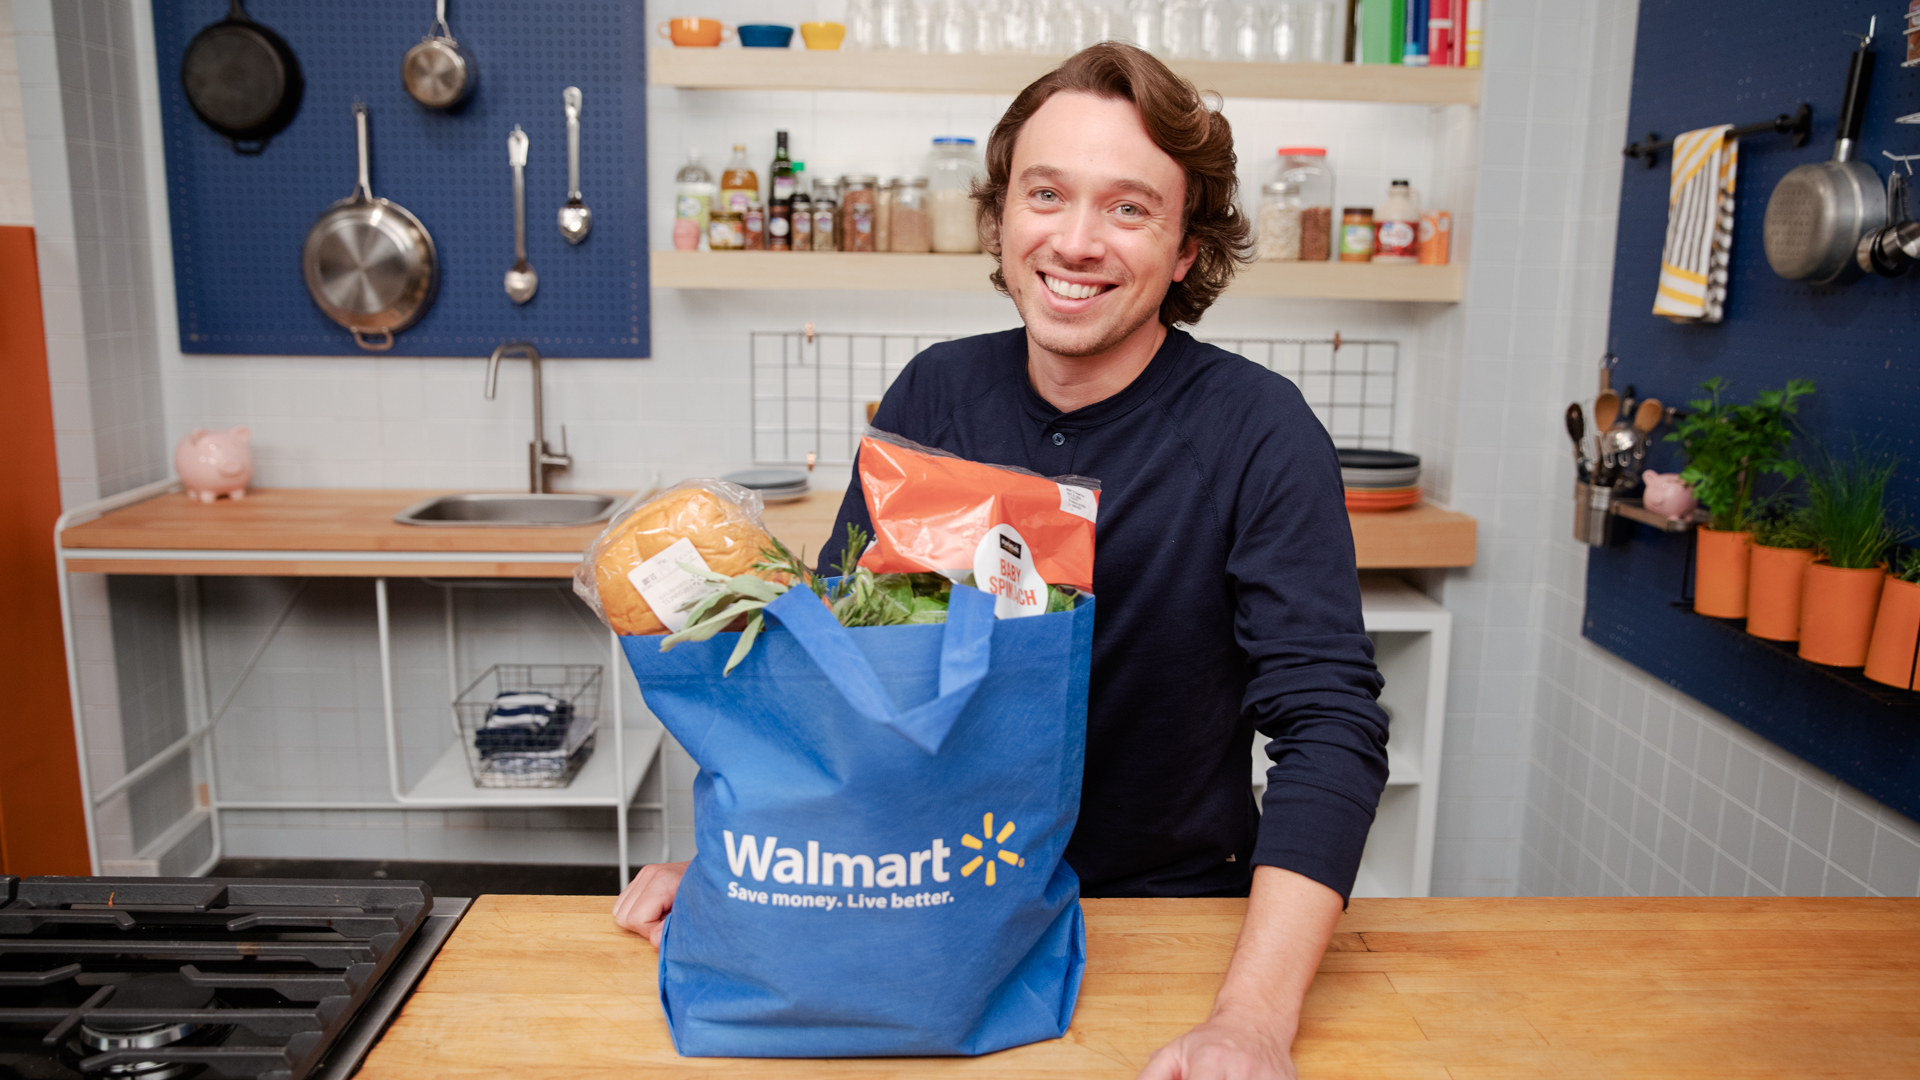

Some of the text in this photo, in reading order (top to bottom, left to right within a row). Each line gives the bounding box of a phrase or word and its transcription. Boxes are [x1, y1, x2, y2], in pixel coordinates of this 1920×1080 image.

[1000, 558, 1021, 582] BABY
[989, 576, 1037, 606] SPINACH
[723, 829, 950, 888] Walmart
[728, 881, 954, 911] Save money. Live better.
